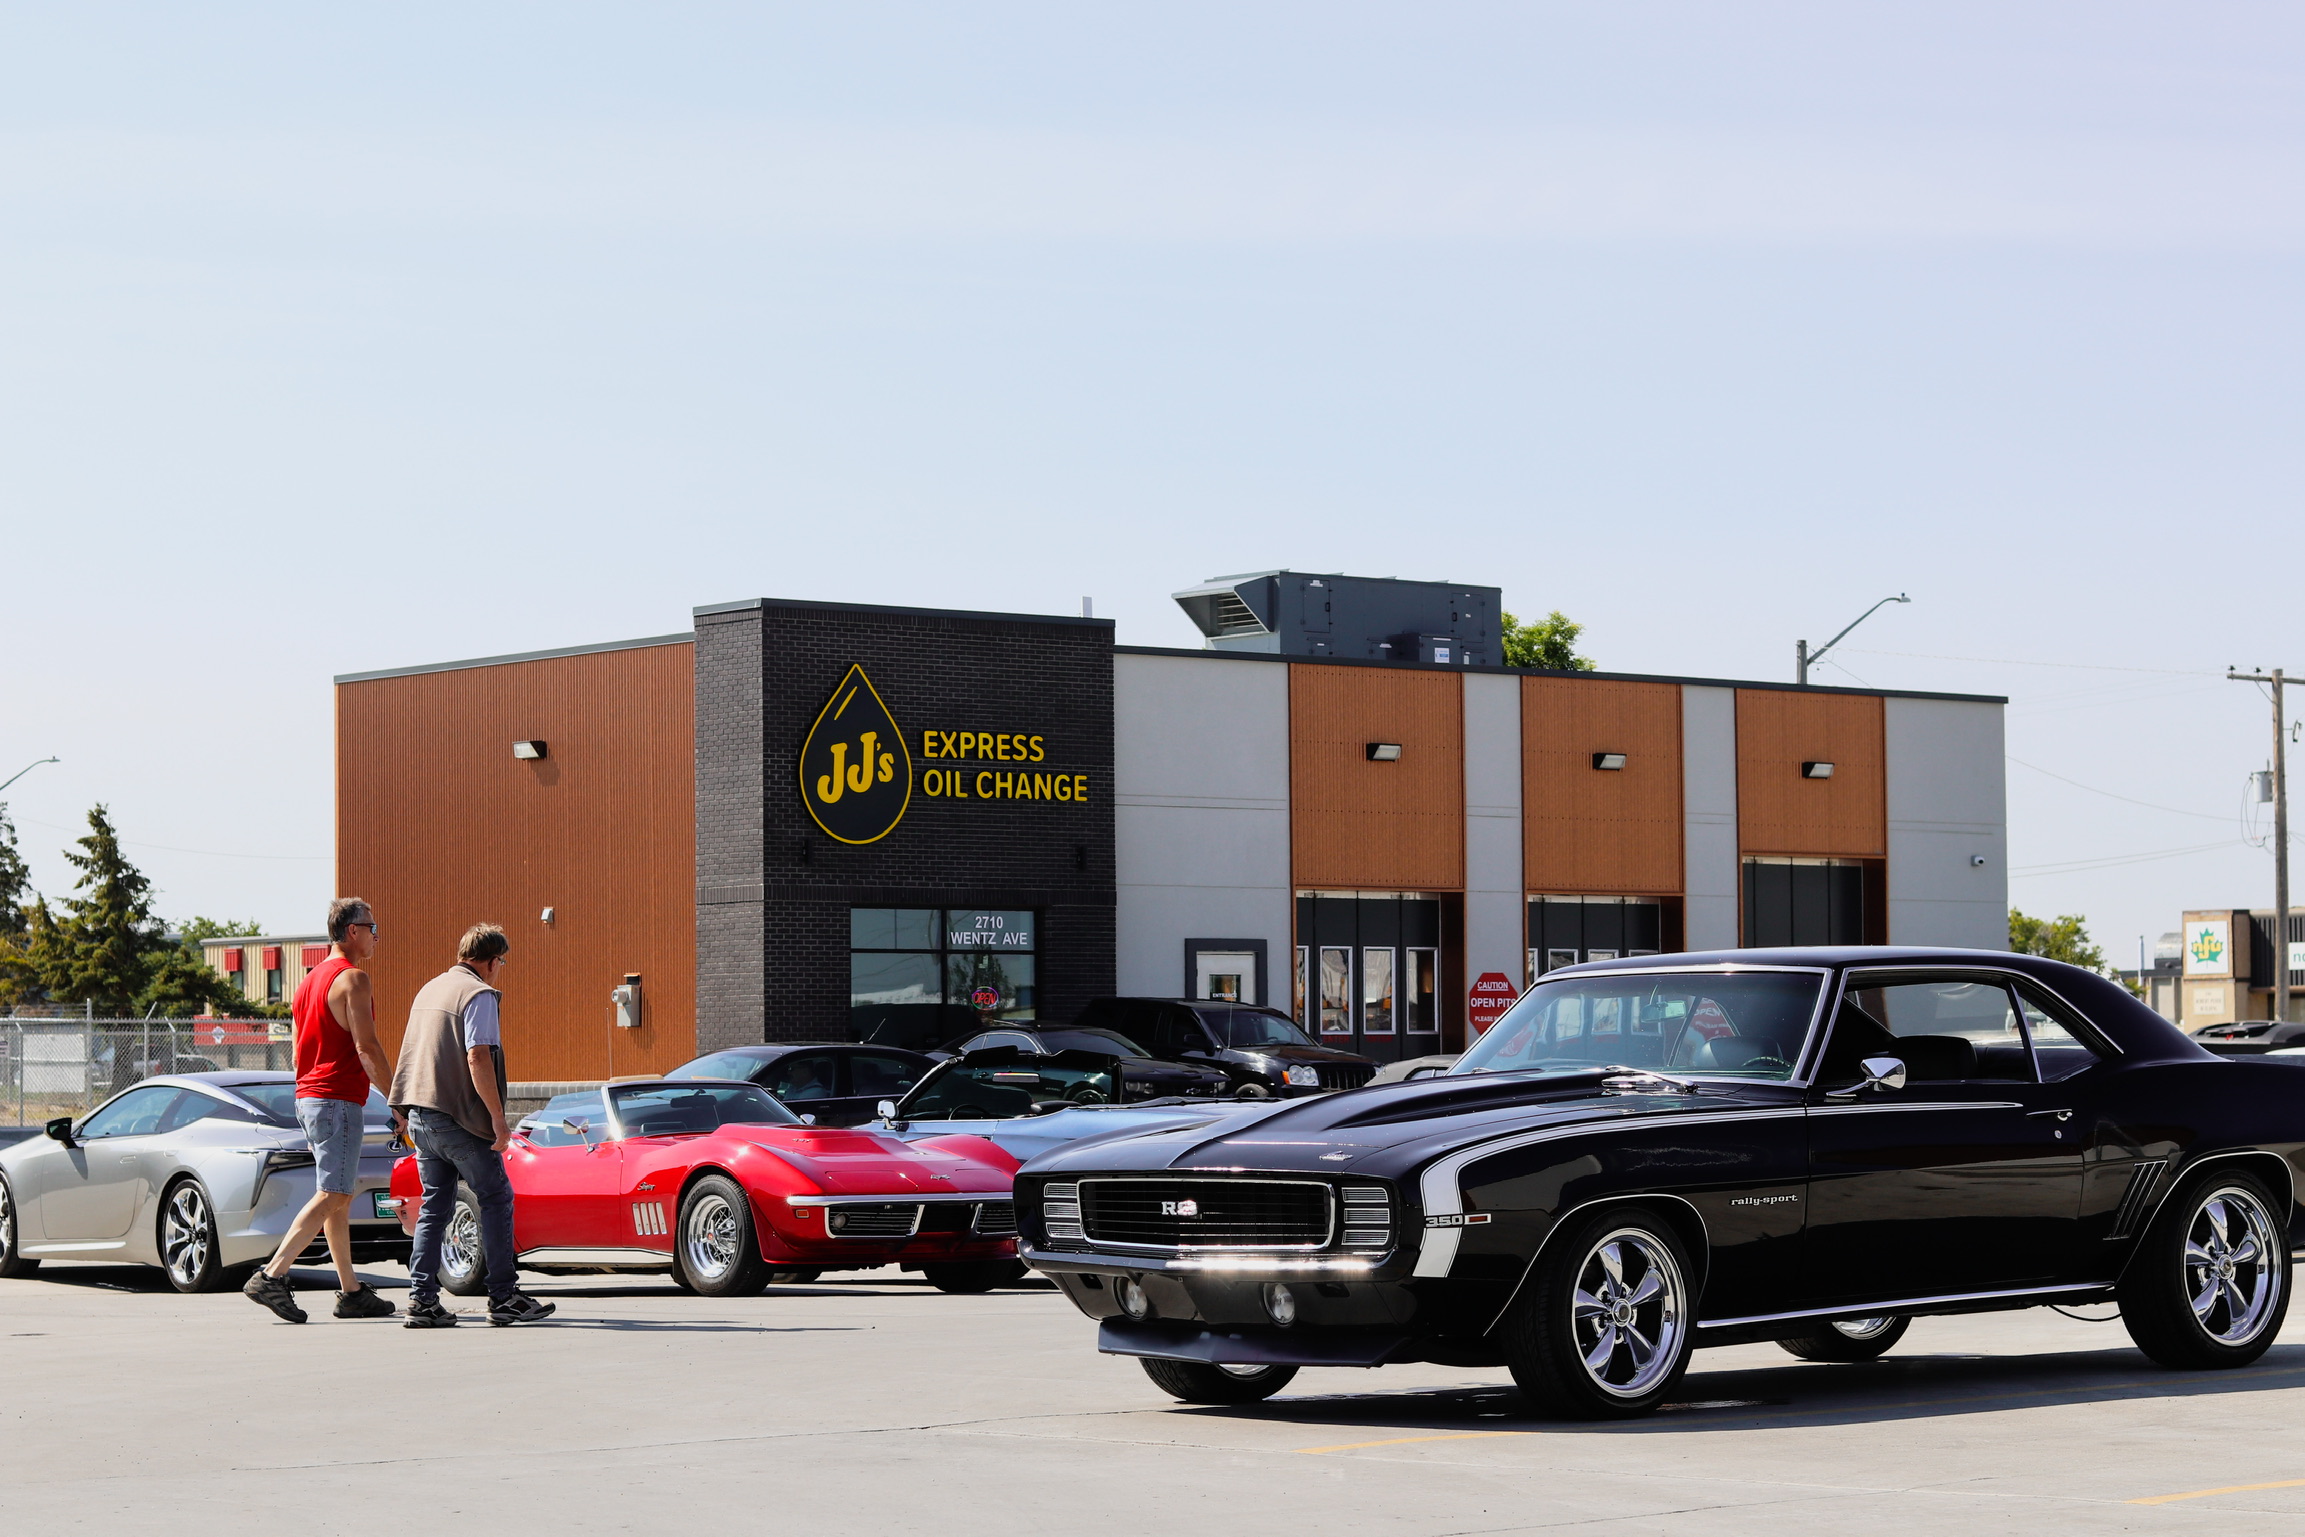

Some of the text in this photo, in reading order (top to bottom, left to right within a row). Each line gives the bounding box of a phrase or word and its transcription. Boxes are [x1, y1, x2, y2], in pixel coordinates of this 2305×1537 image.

[923, 730, 1045, 762] EXPRESS
[817, 731, 895, 804] JJ's
[923, 769, 1088, 802] OIL CHANGE
[975, 916, 1004, 929] 2710
[950, 932, 1028, 945] WENTZ AVE
[1477, 981, 1509, 990] CAUTION
[973, 992, 997, 1005] OPEN
[1470, 997, 1495, 1008] OPEN
[1730, 1194, 1799, 1206] rally-sport
[1425, 1214, 1464, 1228] 350
